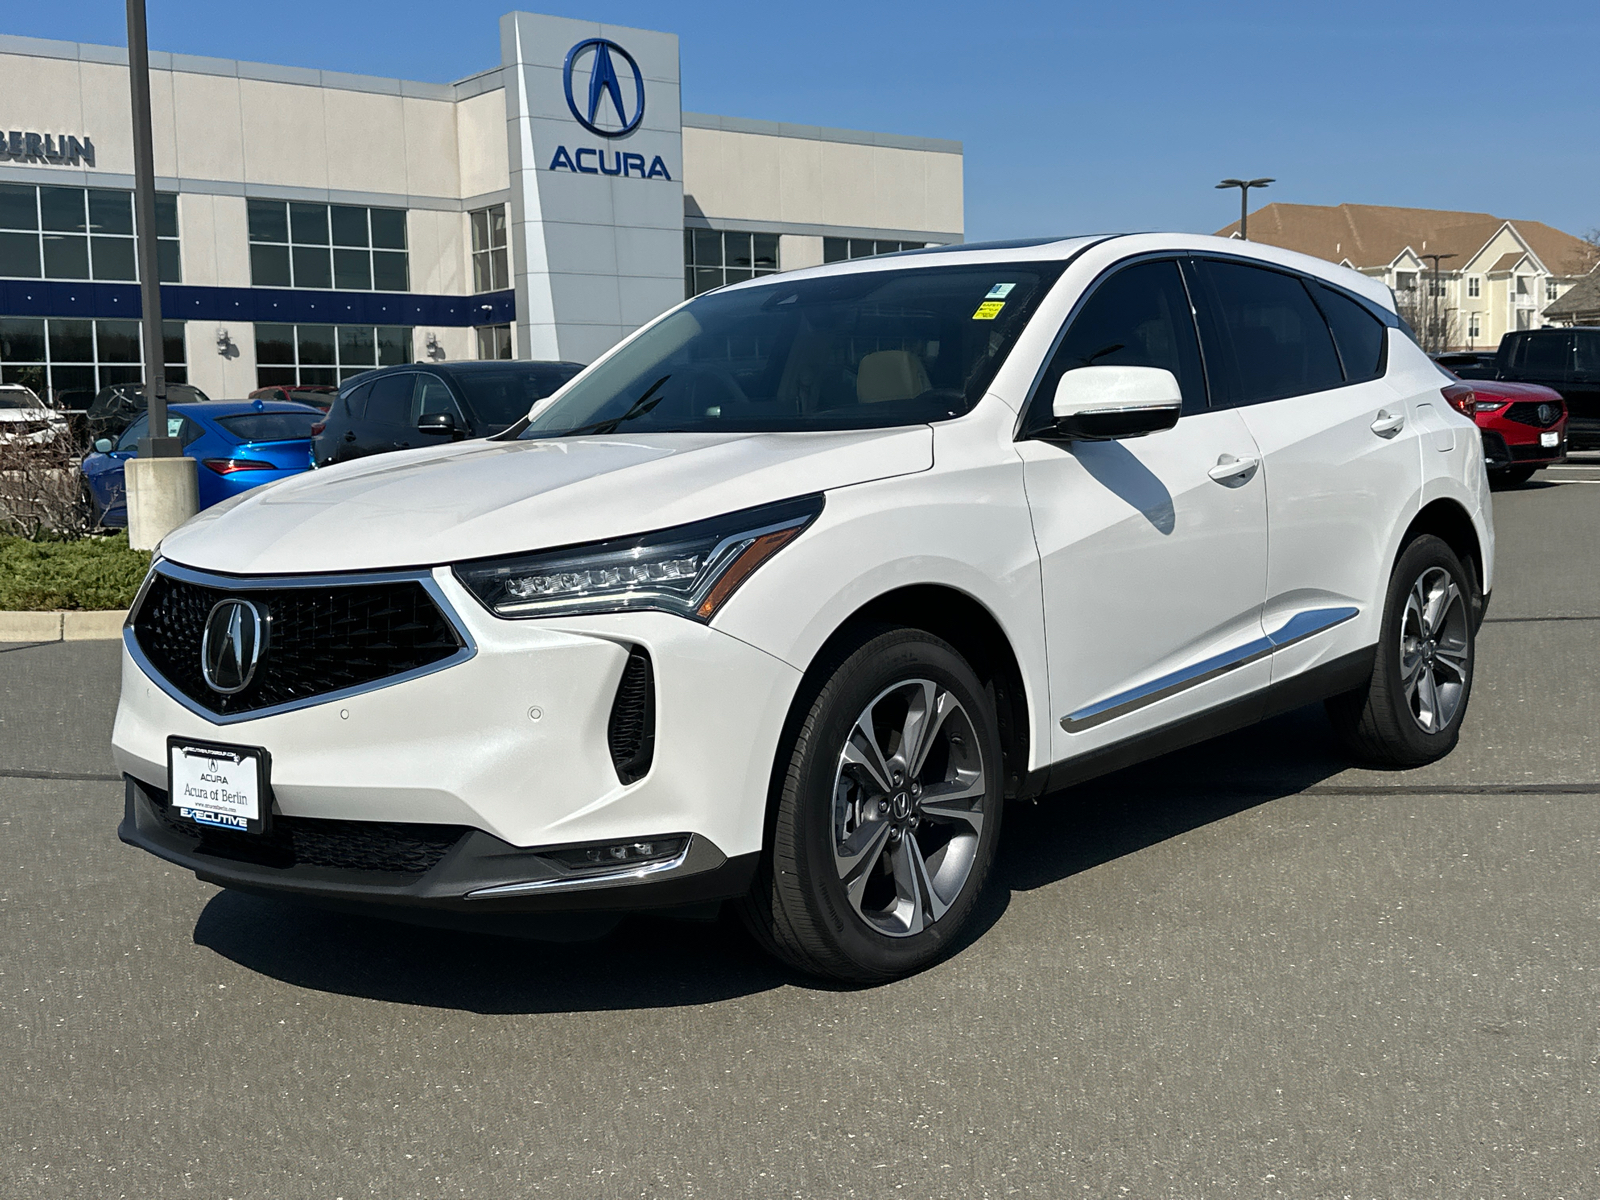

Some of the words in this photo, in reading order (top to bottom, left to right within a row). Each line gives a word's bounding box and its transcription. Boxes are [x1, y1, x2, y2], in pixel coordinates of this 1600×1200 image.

[549, 145, 672, 181] ACURA
[200, 773, 229, 784] ACURA
[184, 783, 208, 800] Acura
[210, 789, 219, 801] of
[221, 789, 248, 806] Berlin
[180, 807, 248, 827] EXECUTIVE
